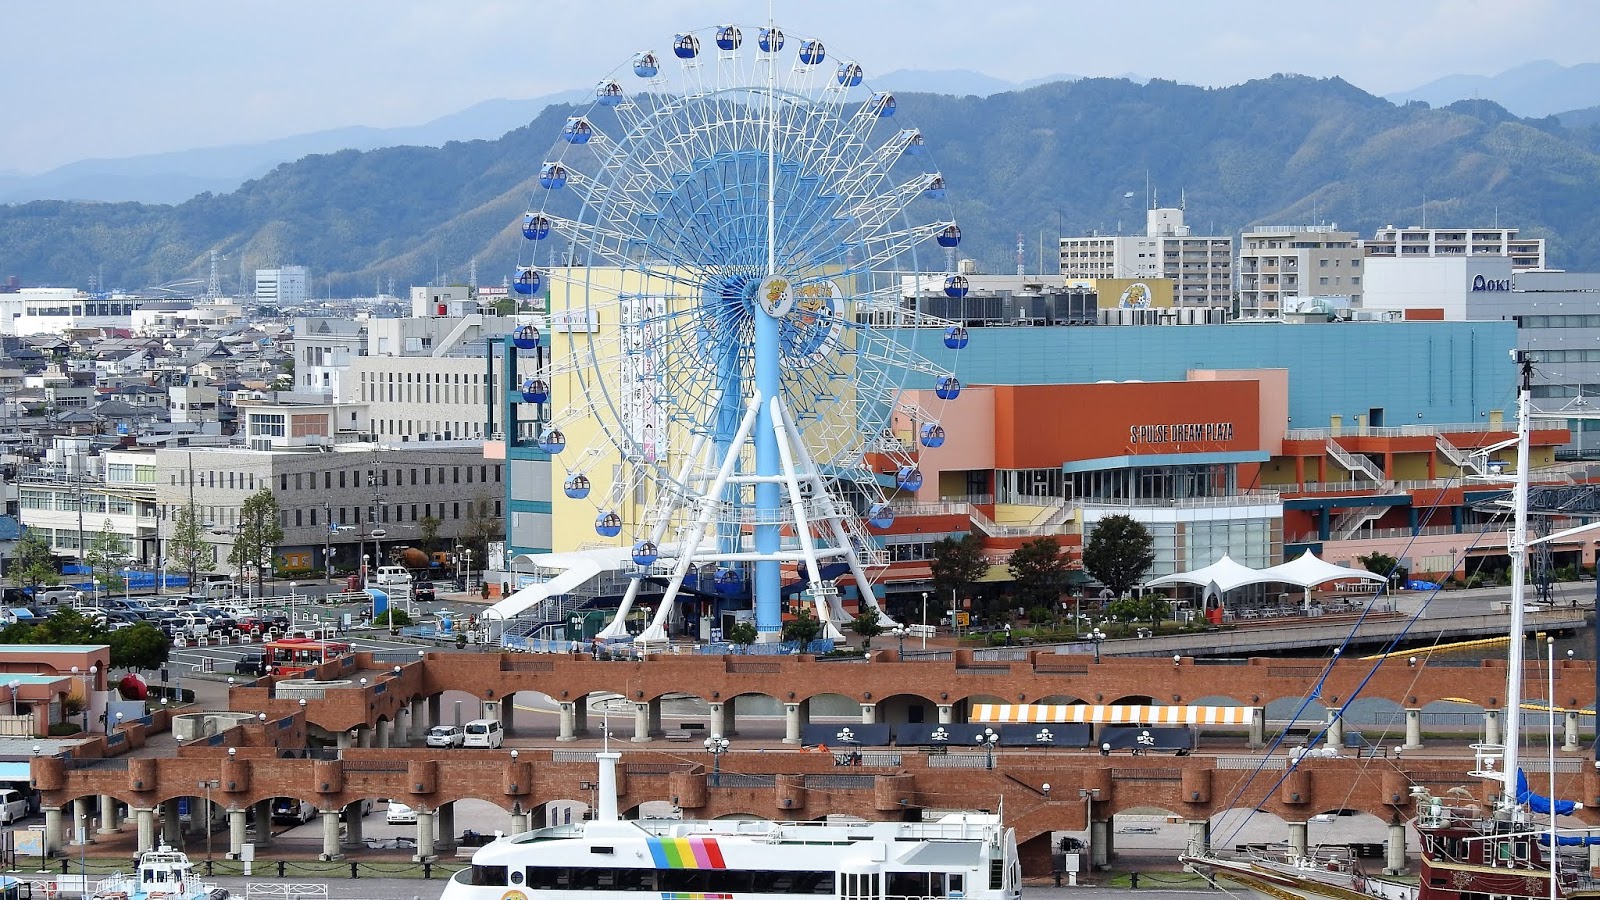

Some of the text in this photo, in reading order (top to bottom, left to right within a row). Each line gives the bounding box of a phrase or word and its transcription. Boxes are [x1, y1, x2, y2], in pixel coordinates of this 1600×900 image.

[1471, 273, 1510, 291] AOKI
[1170, 423, 1203, 442] DREAM
[1205, 422, 1233, 441] PLAZA
